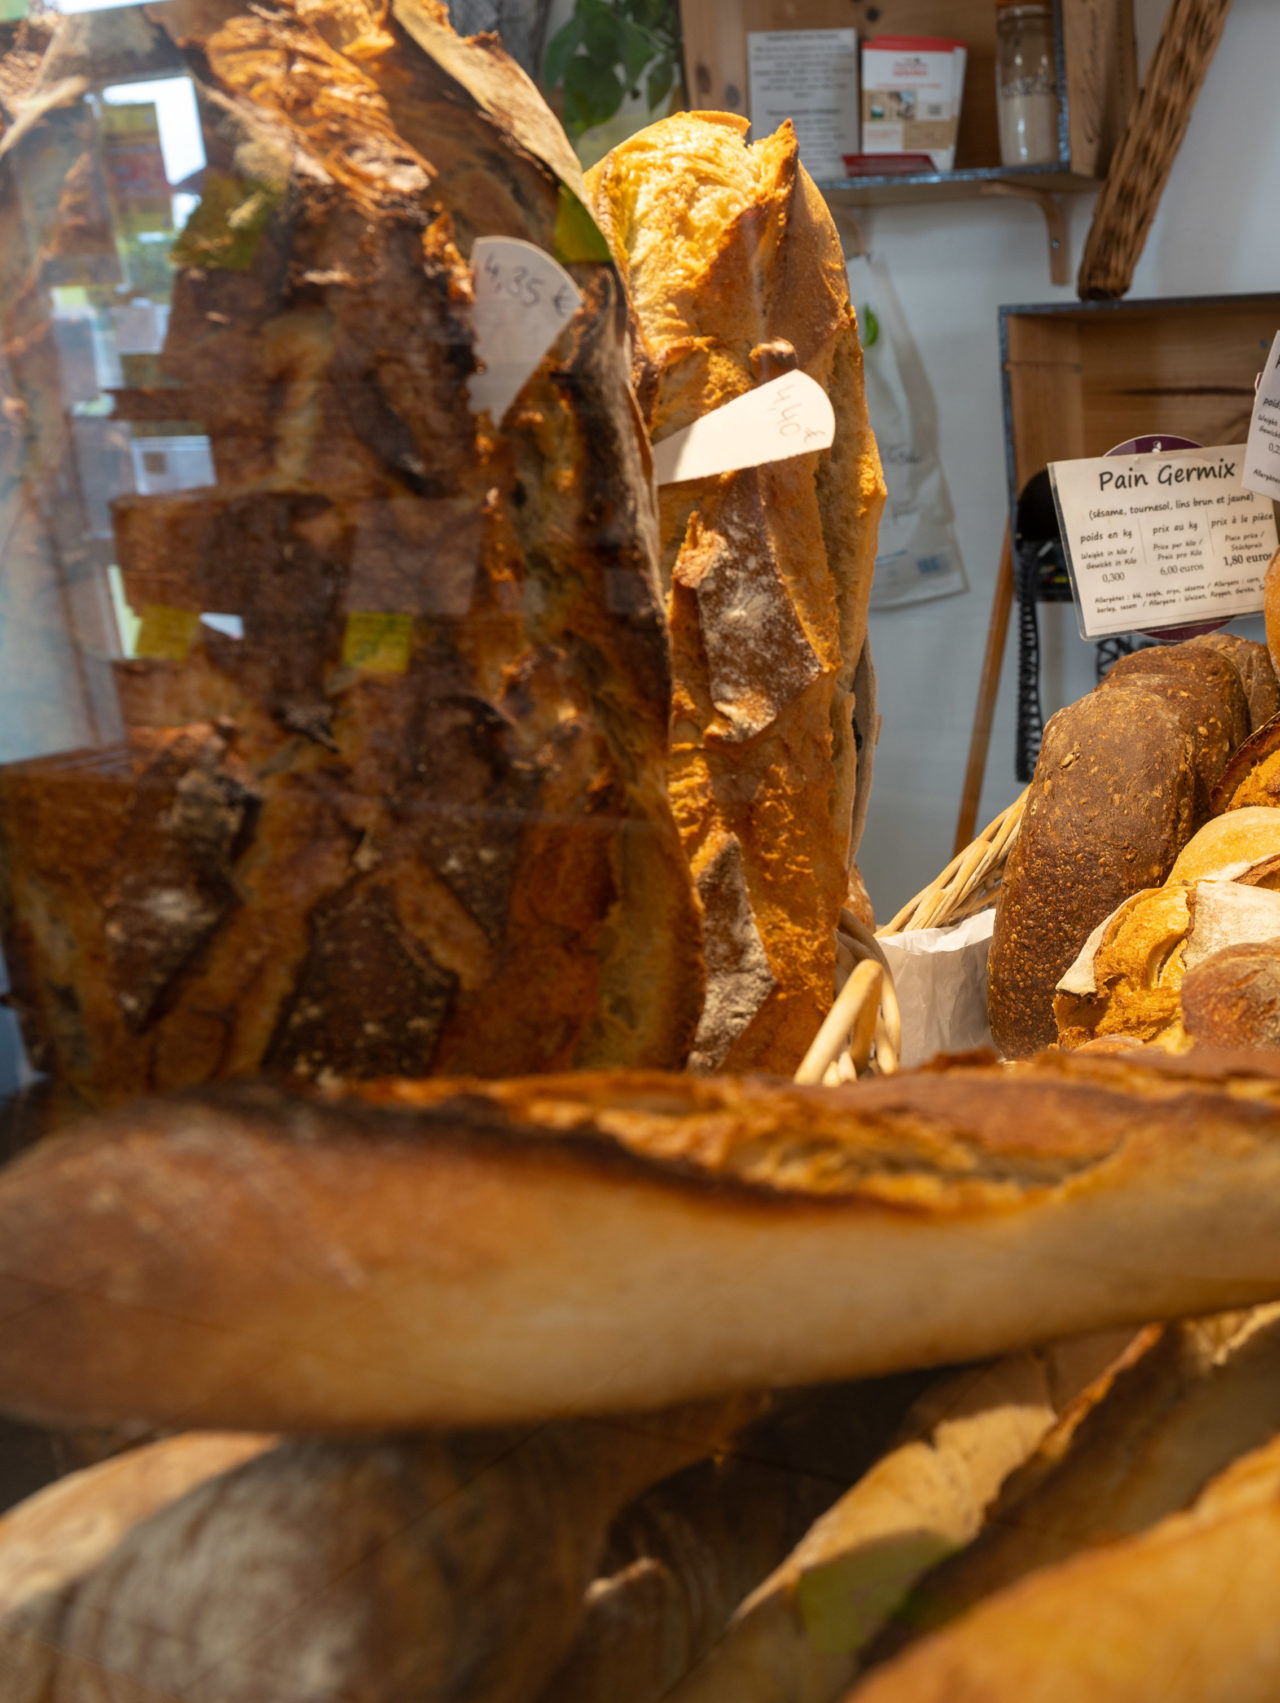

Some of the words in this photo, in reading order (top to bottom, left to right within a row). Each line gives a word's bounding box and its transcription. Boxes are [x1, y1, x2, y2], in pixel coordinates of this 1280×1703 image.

[1099, 467, 1148, 492] Pain
[1157, 458, 1236, 485] Germix
[1088, 508, 1127, 520] (sésame,
[1129, 501, 1173, 515] tournesol,
[1175, 499, 1190, 509] lins
[1193, 496, 1214, 506] brun
[1216, 495, 1225, 504] et
[1227, 493, 1255, 506] jaune)
[1153, 524, 1169, 535] prix
[1188, 521, 1198, 531] kg
[1211, 519, 1227, 529] prix
[1252, 513, 1273, 524] pièce
[1080, 531, 1103, 545] poids
[1123, 529, 1132, 539] kg
[1223, 554, 1243, 567] 1,80
[1160, 565, 1178, 576] 6,00
[1179, 563, 1204, 573] euros
[1102, 572, 1125, 583] 0,300
